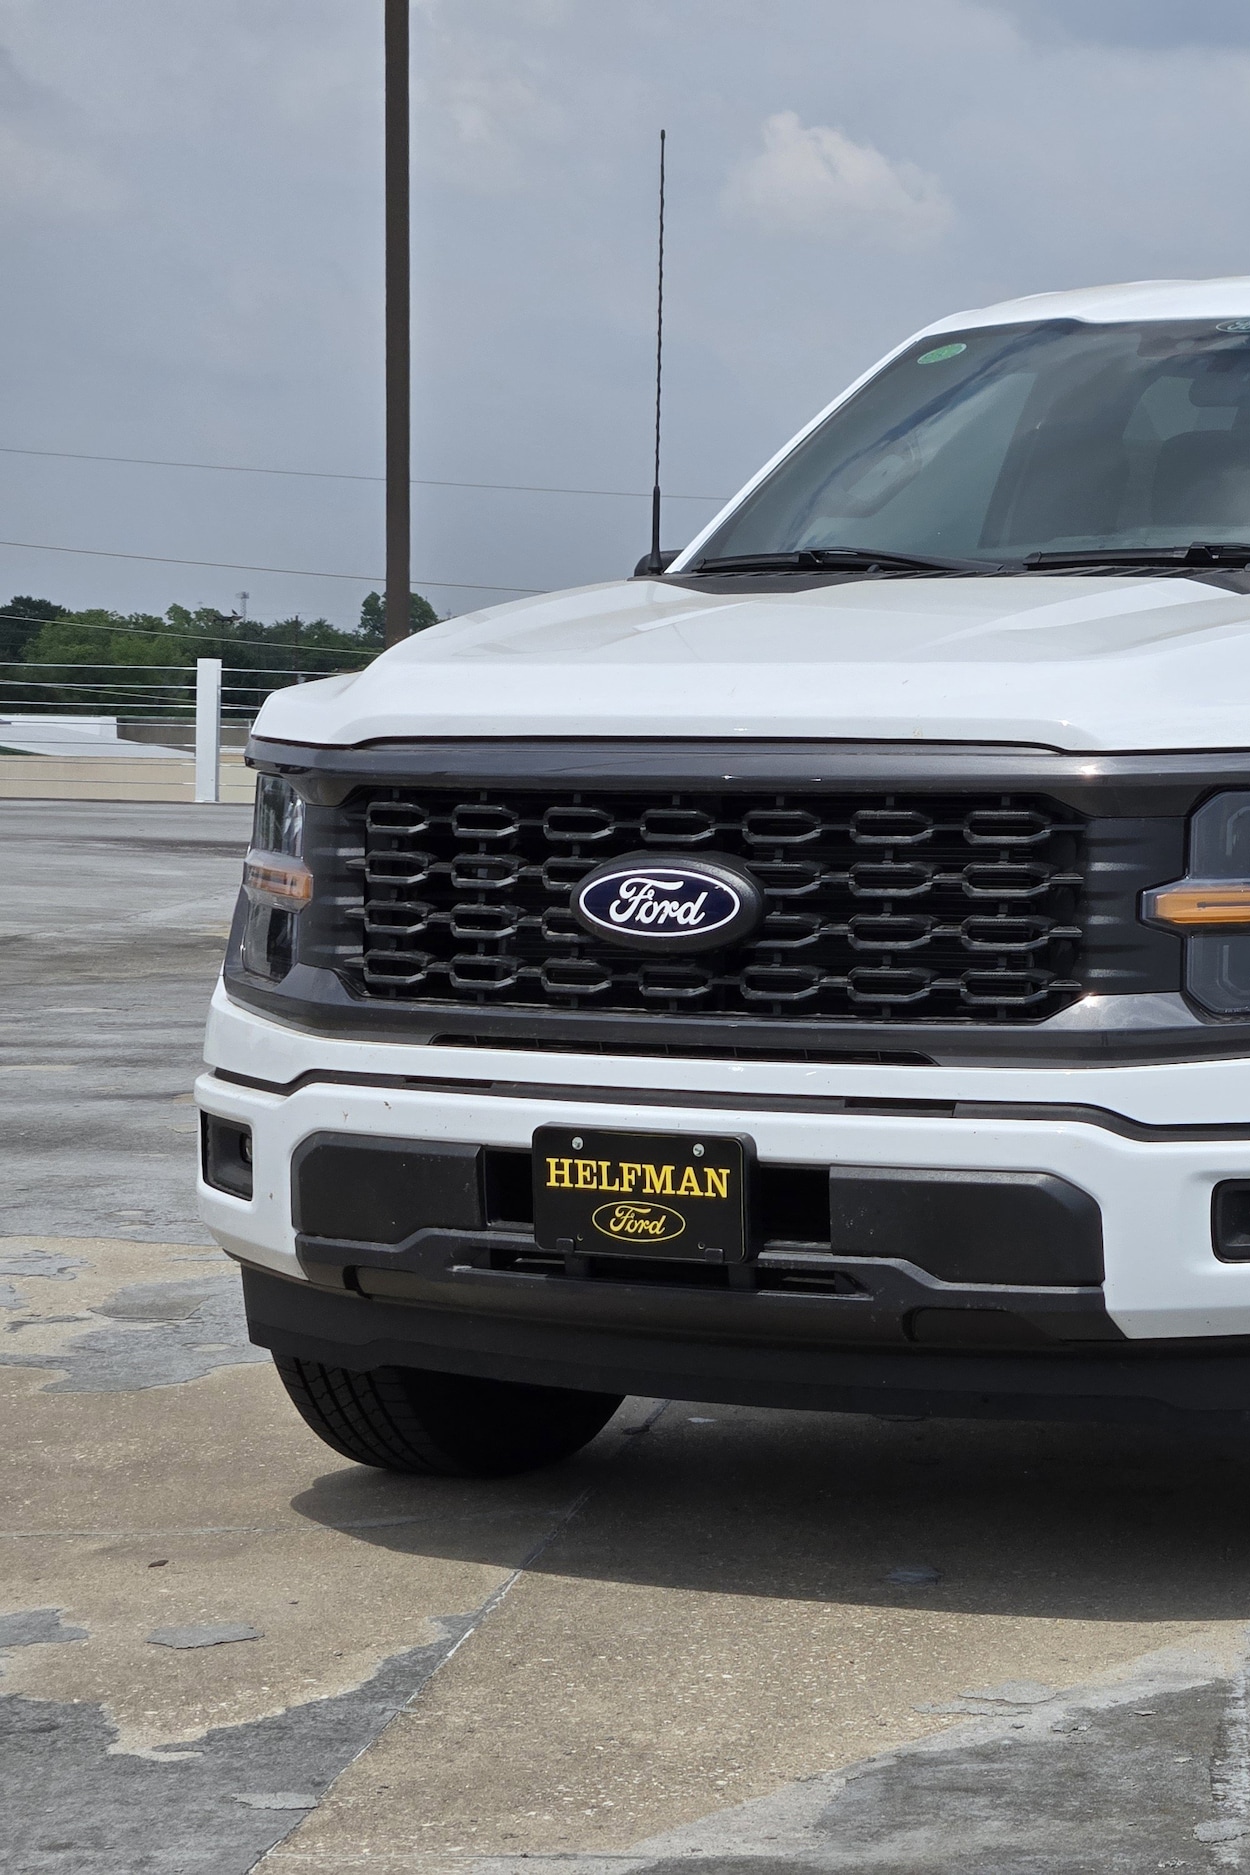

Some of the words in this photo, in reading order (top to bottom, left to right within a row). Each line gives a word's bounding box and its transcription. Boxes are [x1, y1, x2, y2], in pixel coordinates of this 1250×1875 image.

[609, 877, 709, 926] Ford
[545, 1157, 731, 1198] HELFMAN
[609, 1205, 667, 1236] Ford
